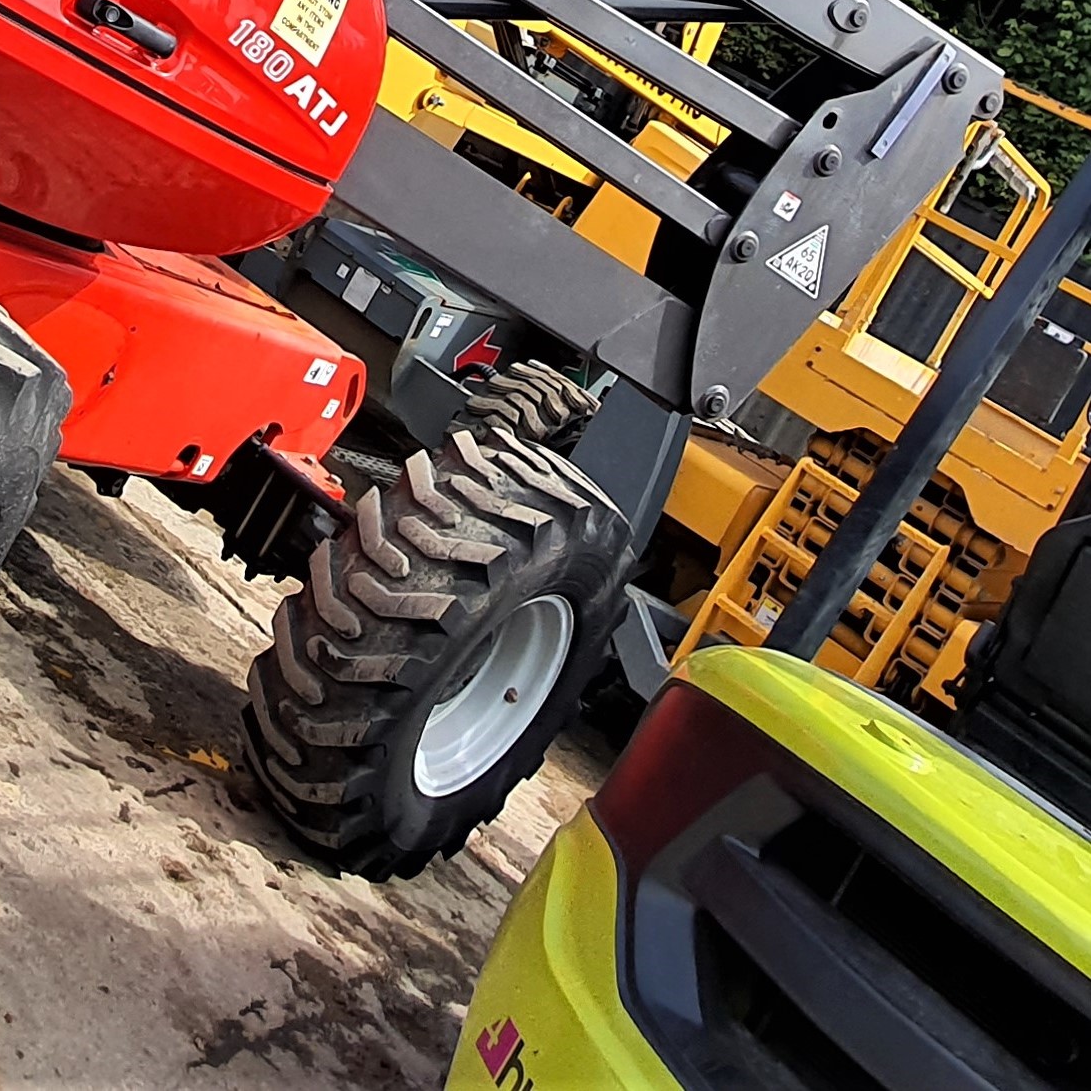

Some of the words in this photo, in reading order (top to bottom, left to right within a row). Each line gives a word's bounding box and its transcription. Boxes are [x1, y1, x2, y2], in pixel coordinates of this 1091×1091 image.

[228, 19, 295, 83] 180
[283, 74, 349, 137] ATJ
[801, 247, 818, 262] 65
[785, 256, 815, 282] AK20
